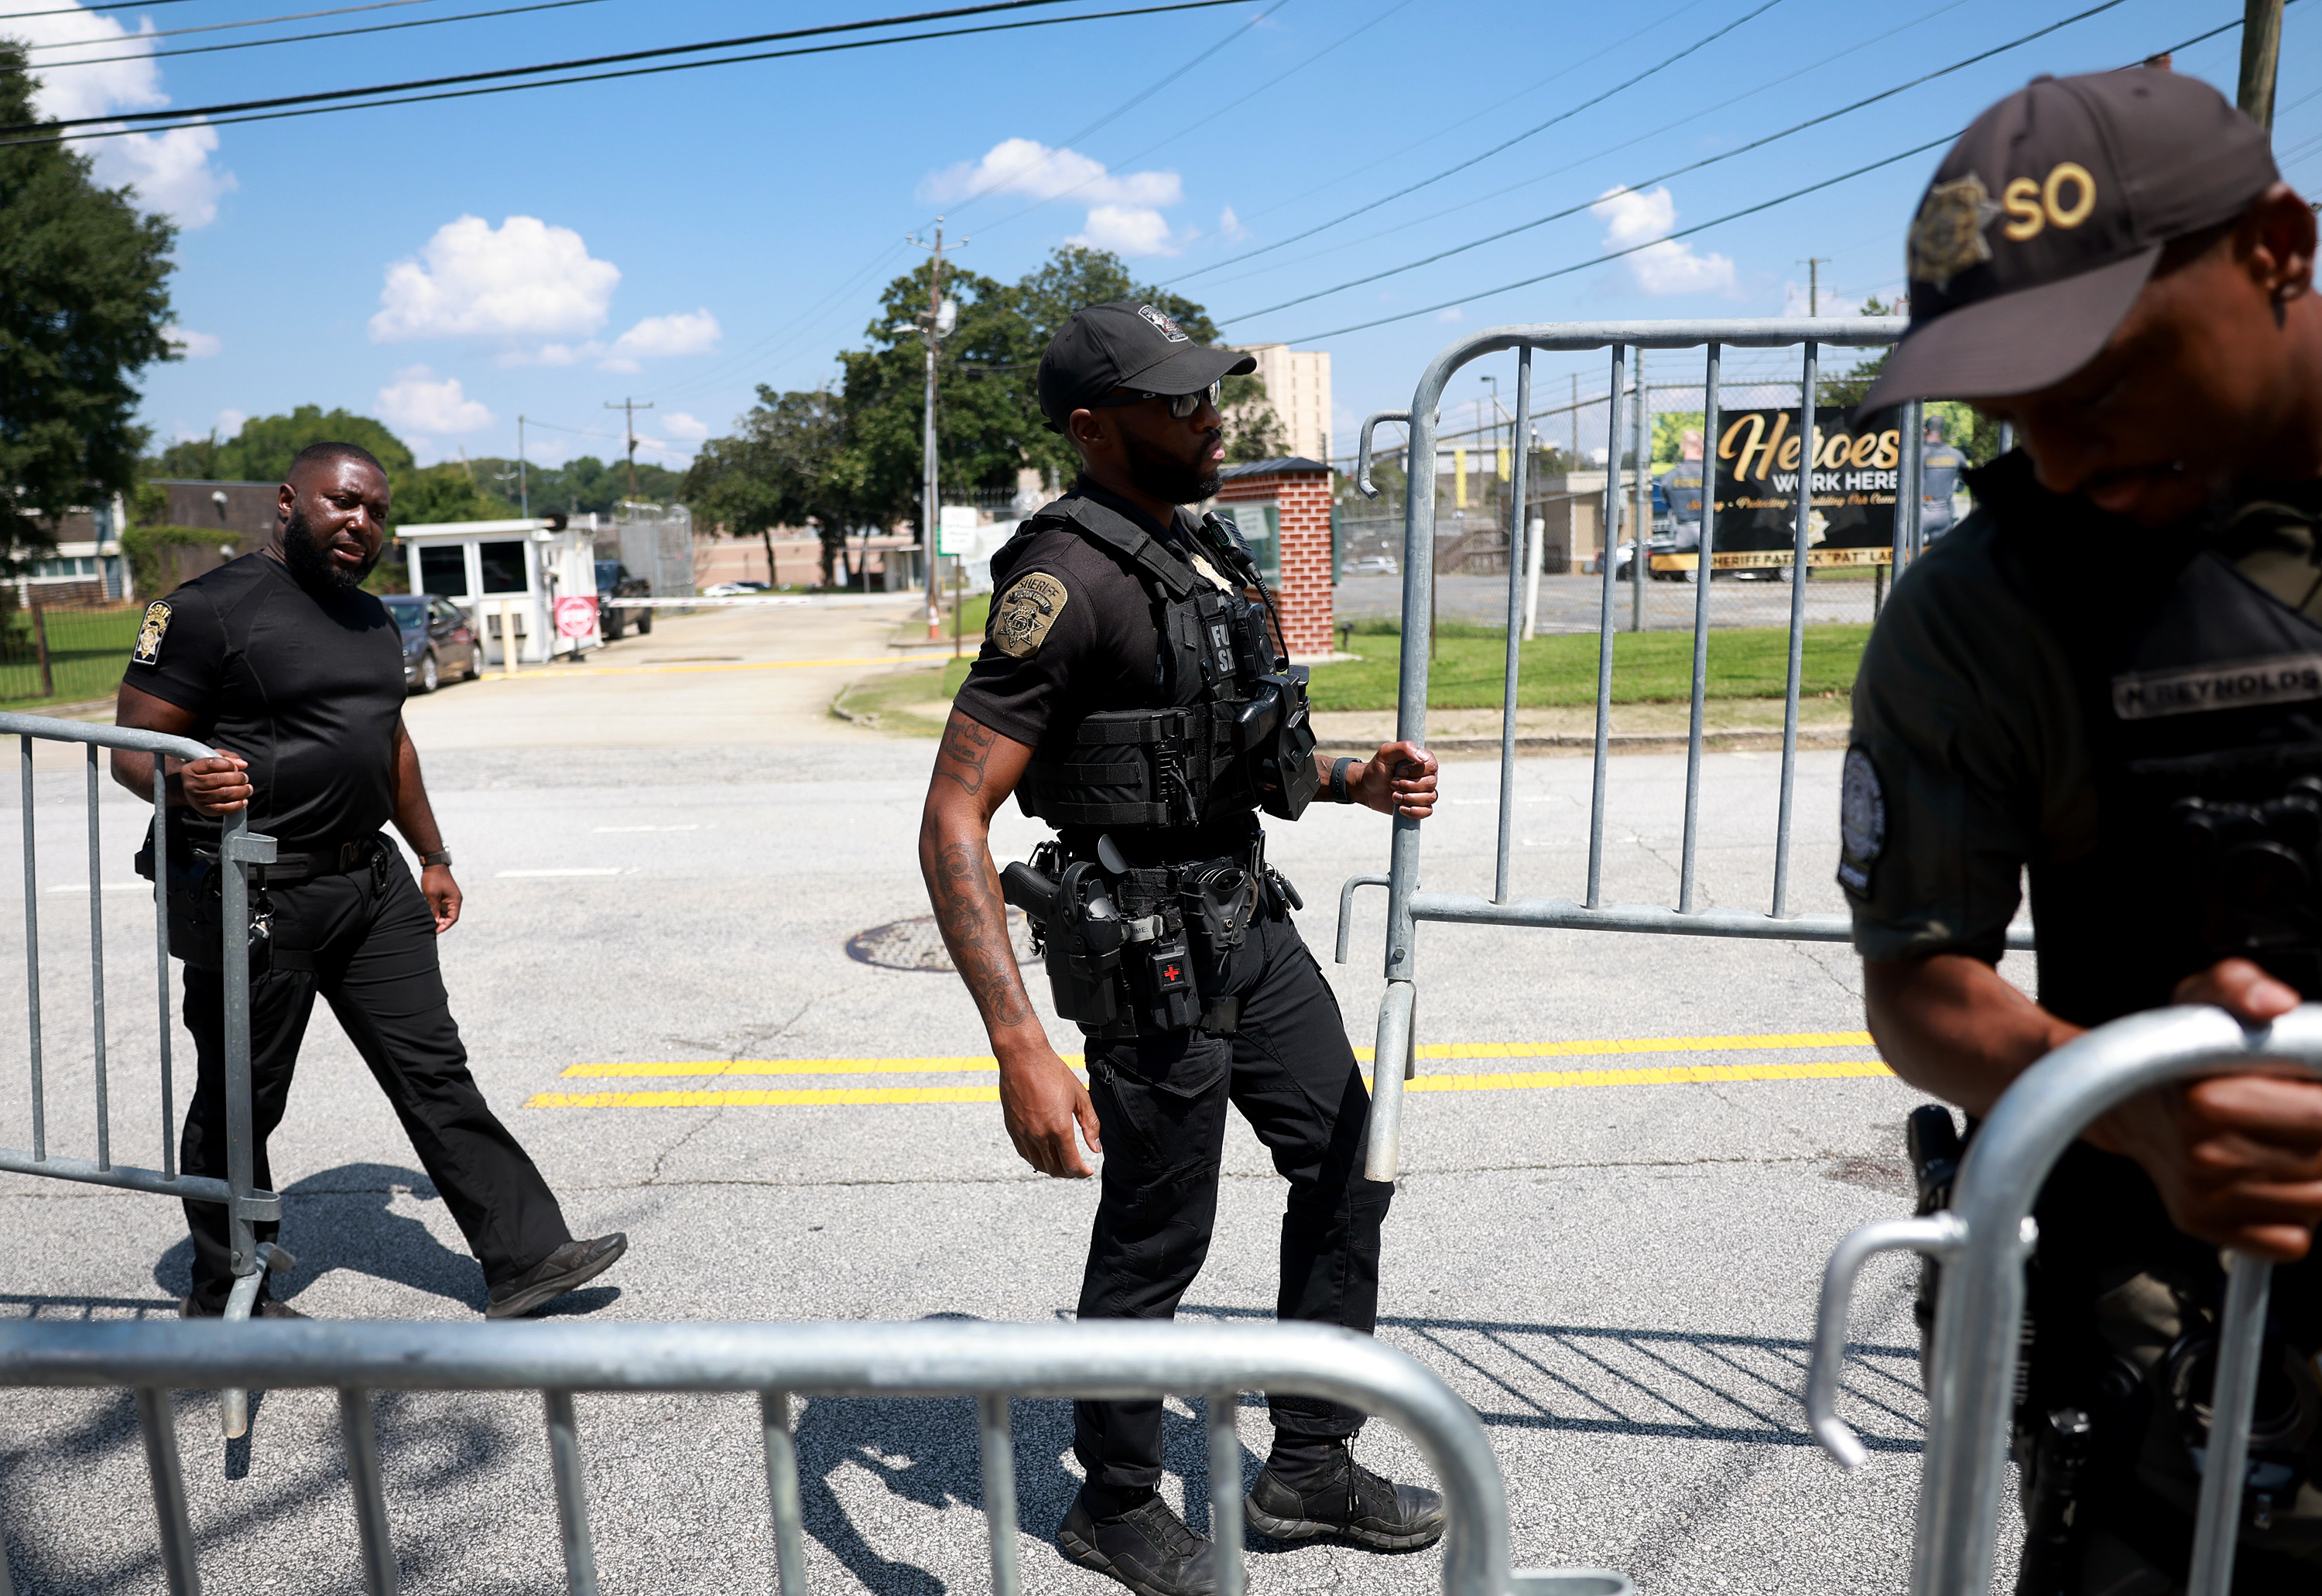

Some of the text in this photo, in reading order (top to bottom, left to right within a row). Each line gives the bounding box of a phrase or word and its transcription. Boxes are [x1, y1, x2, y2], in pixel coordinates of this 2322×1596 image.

[2002, 161, 2098, 242] SO
[1772, 472, 1841, 492] WRK
[1711, 555, 1760, 567] HERIFF
[1018, 578, 1060, 598] SHERIFF
[1015, 591, 1051, 608] FULTON COUNTY
